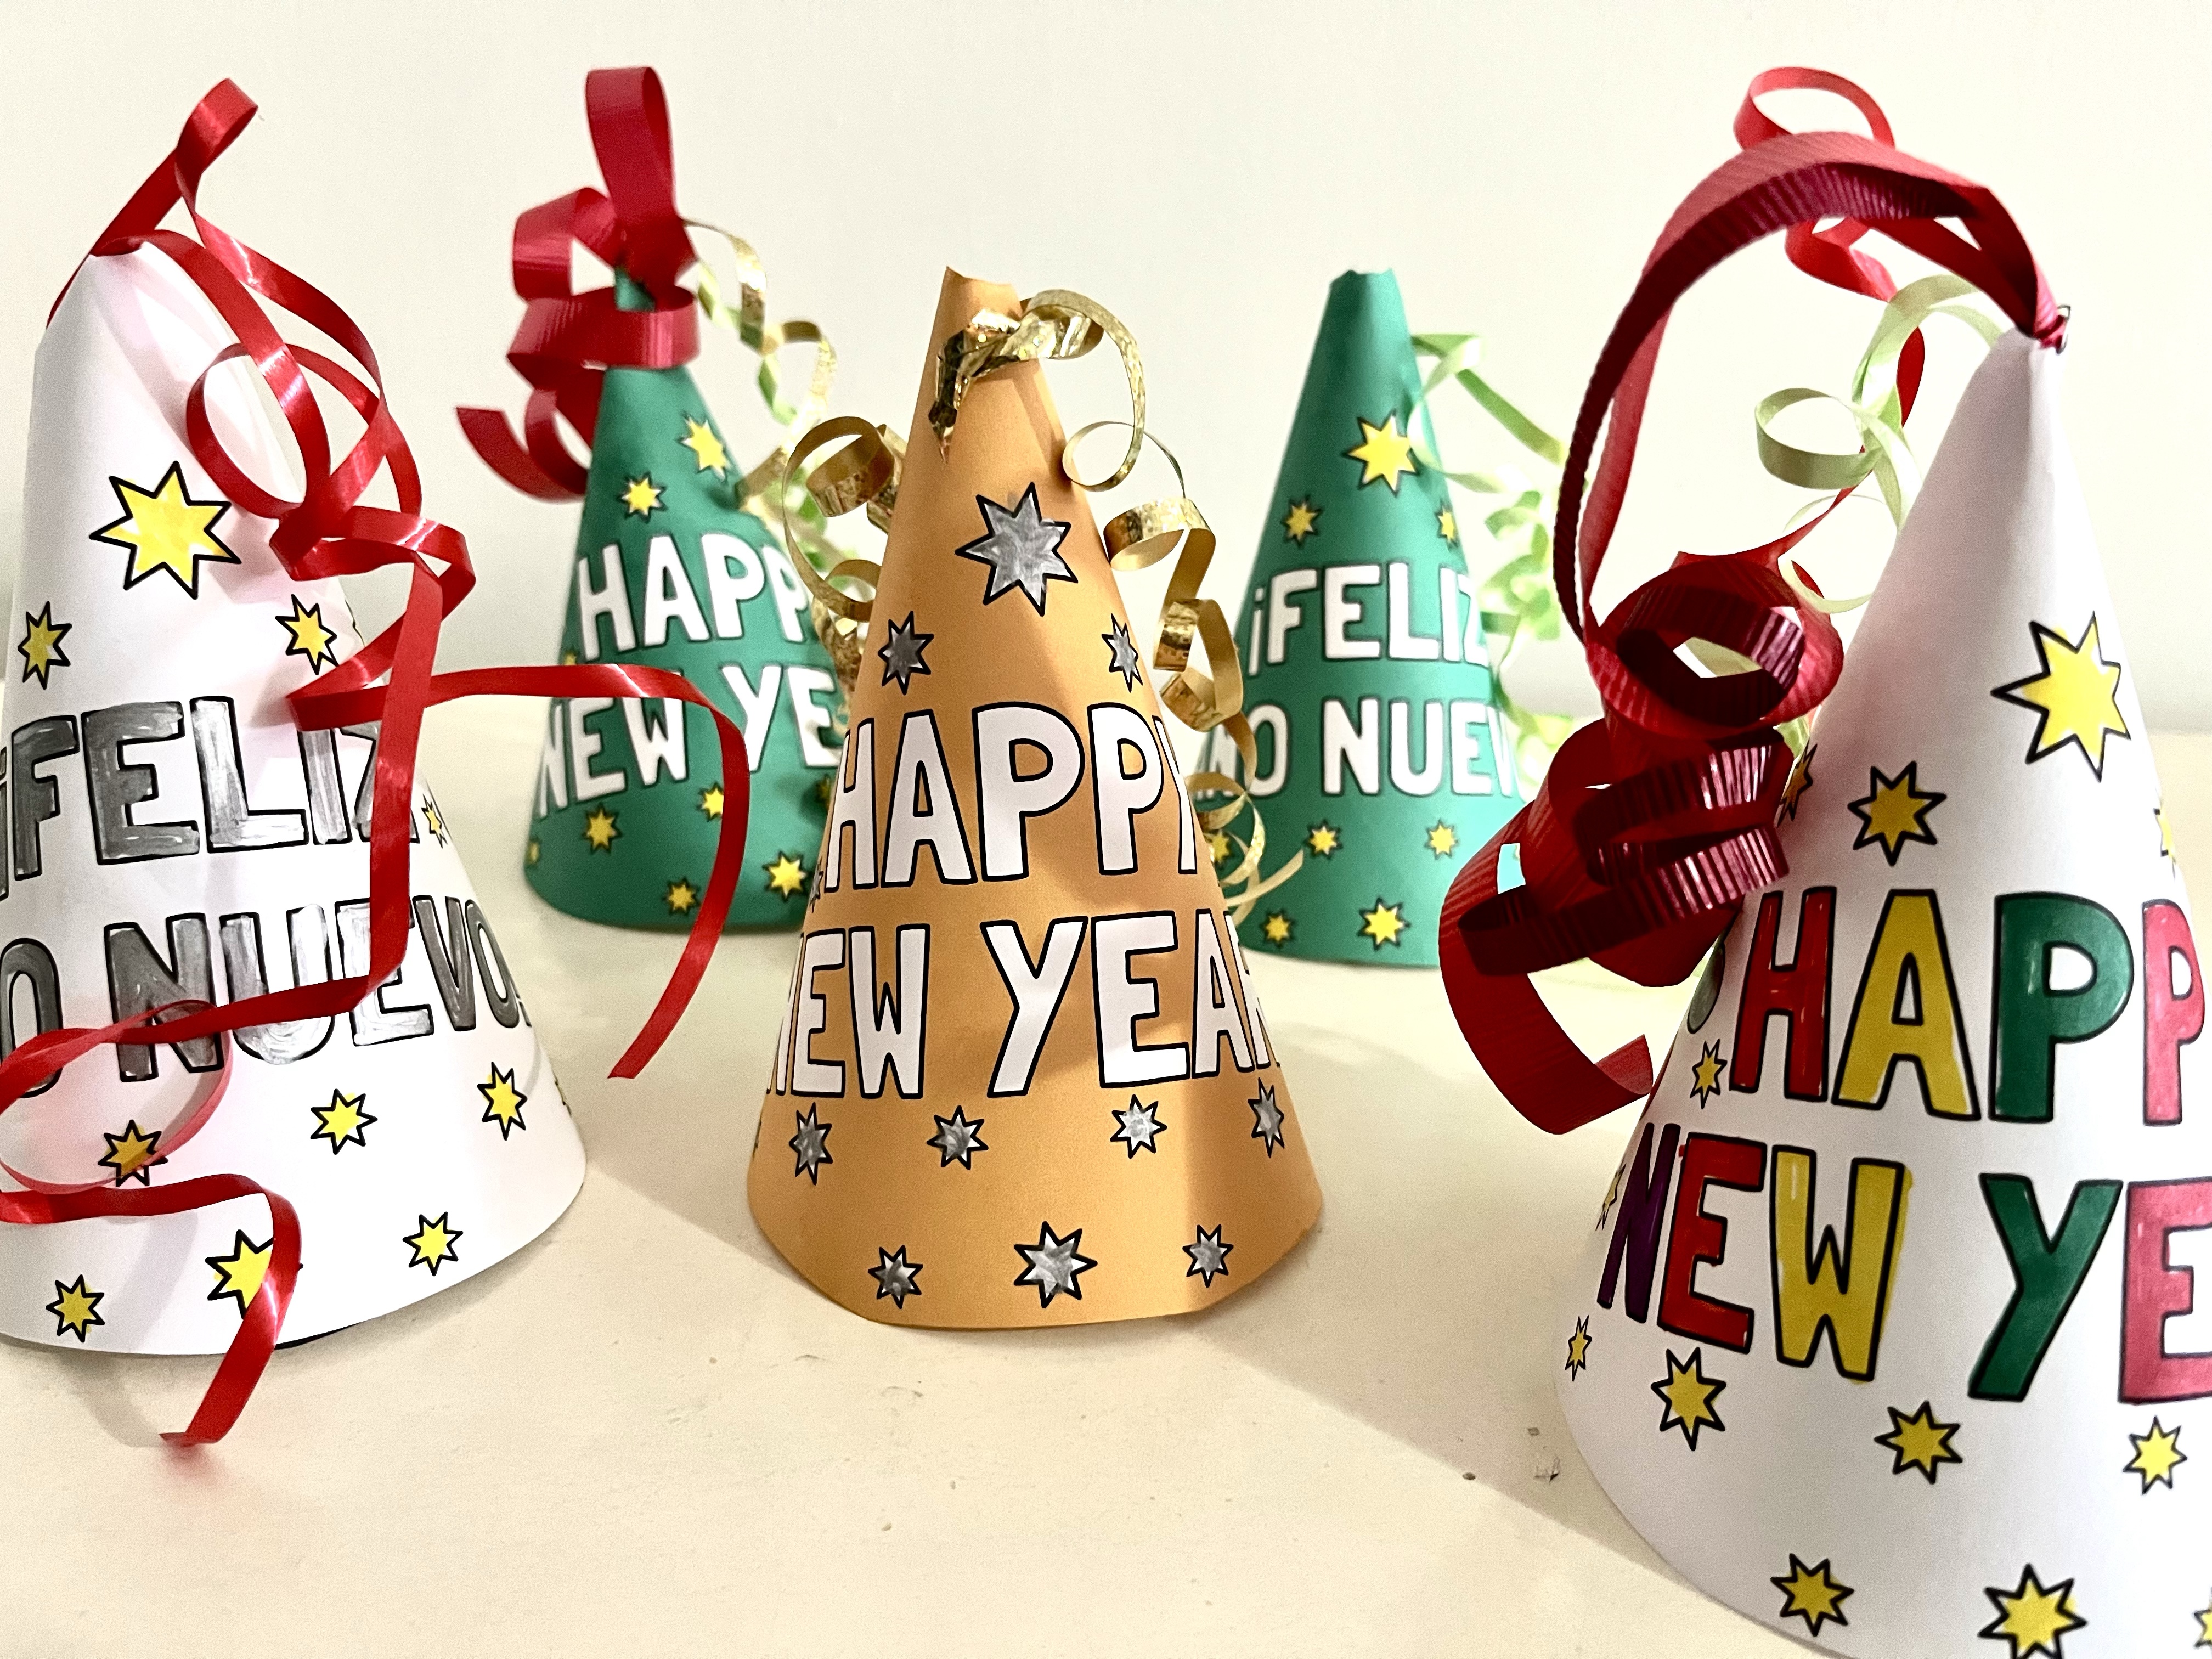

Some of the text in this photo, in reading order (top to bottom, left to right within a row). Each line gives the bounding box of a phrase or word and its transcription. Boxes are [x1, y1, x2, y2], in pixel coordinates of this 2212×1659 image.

[1322, 697, 1519, 798] NUEV
[104, 894, 532, 1083] NUEVO
[1596, 1122, 1911, 1383] NEW
